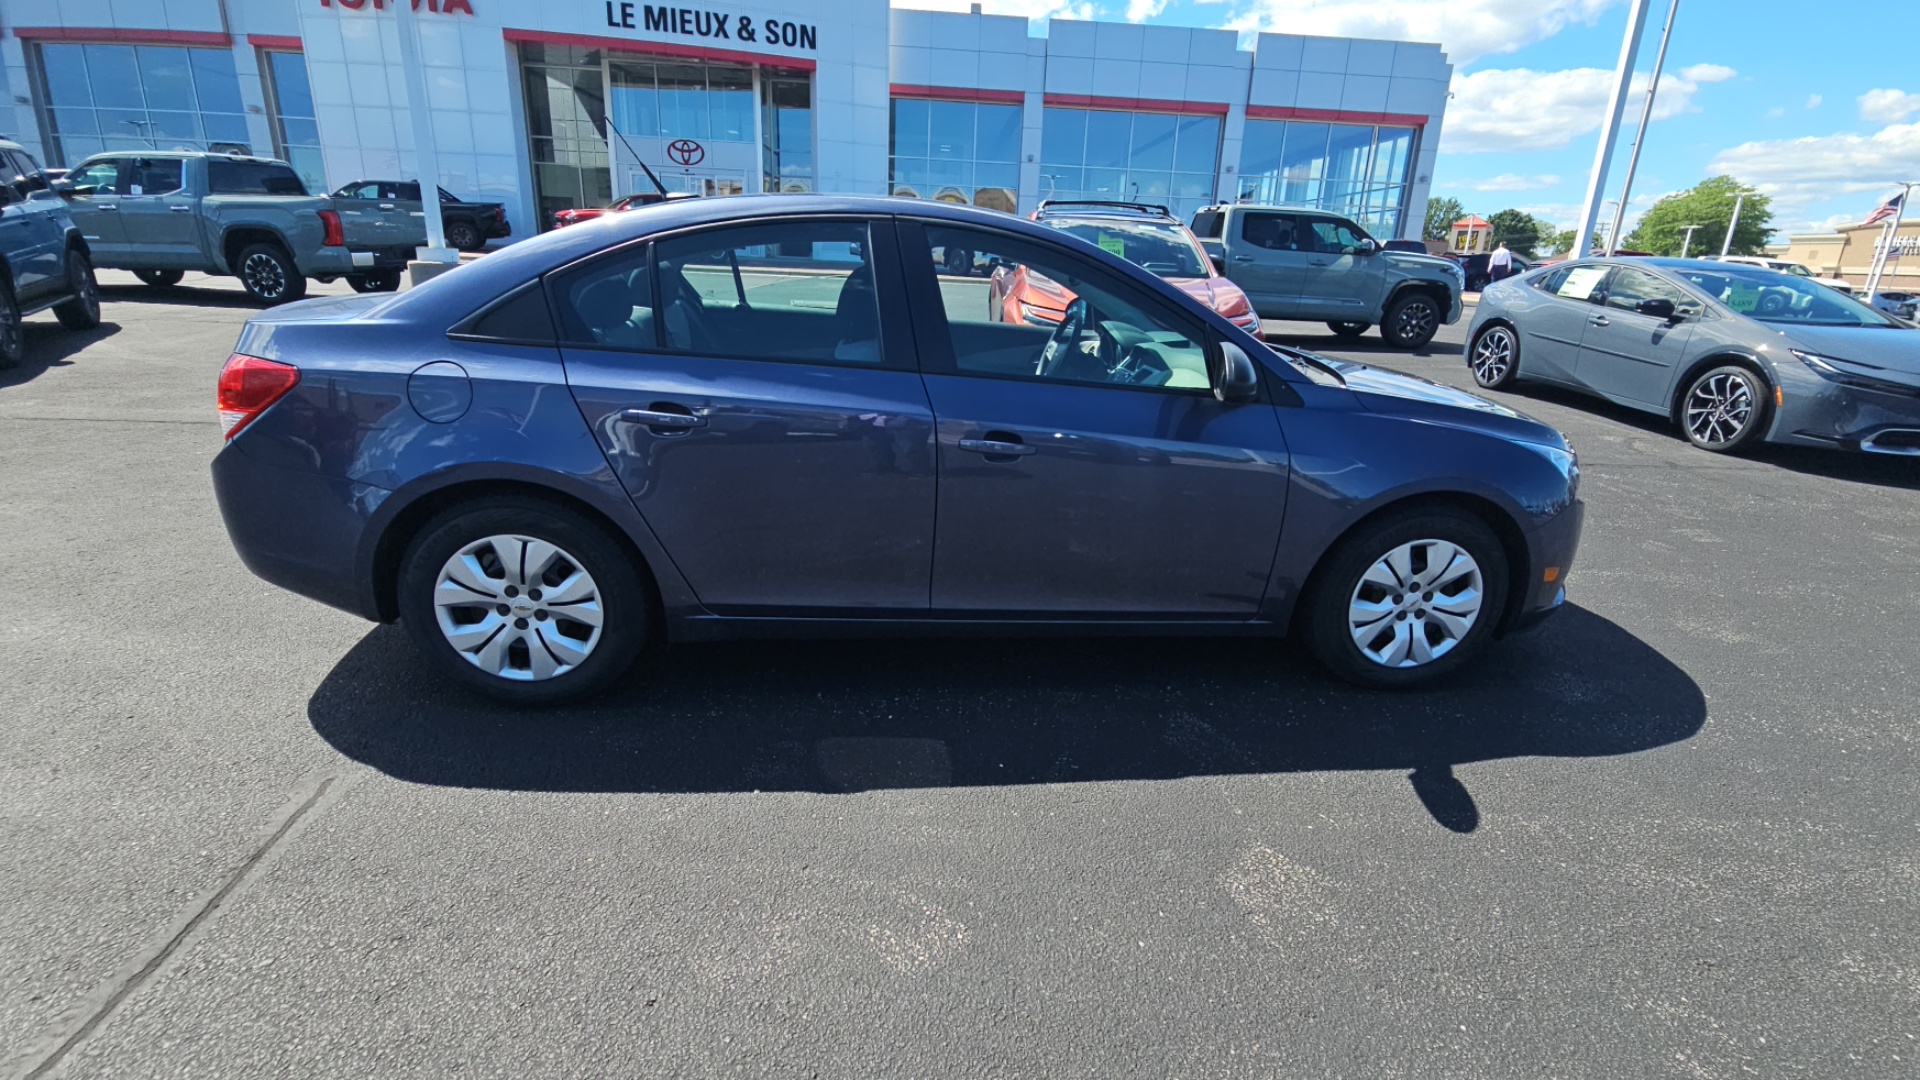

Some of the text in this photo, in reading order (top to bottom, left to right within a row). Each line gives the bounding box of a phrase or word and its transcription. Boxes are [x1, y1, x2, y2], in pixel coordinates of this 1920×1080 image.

[606, 1, 817, 50] LE MIEUX & SON
